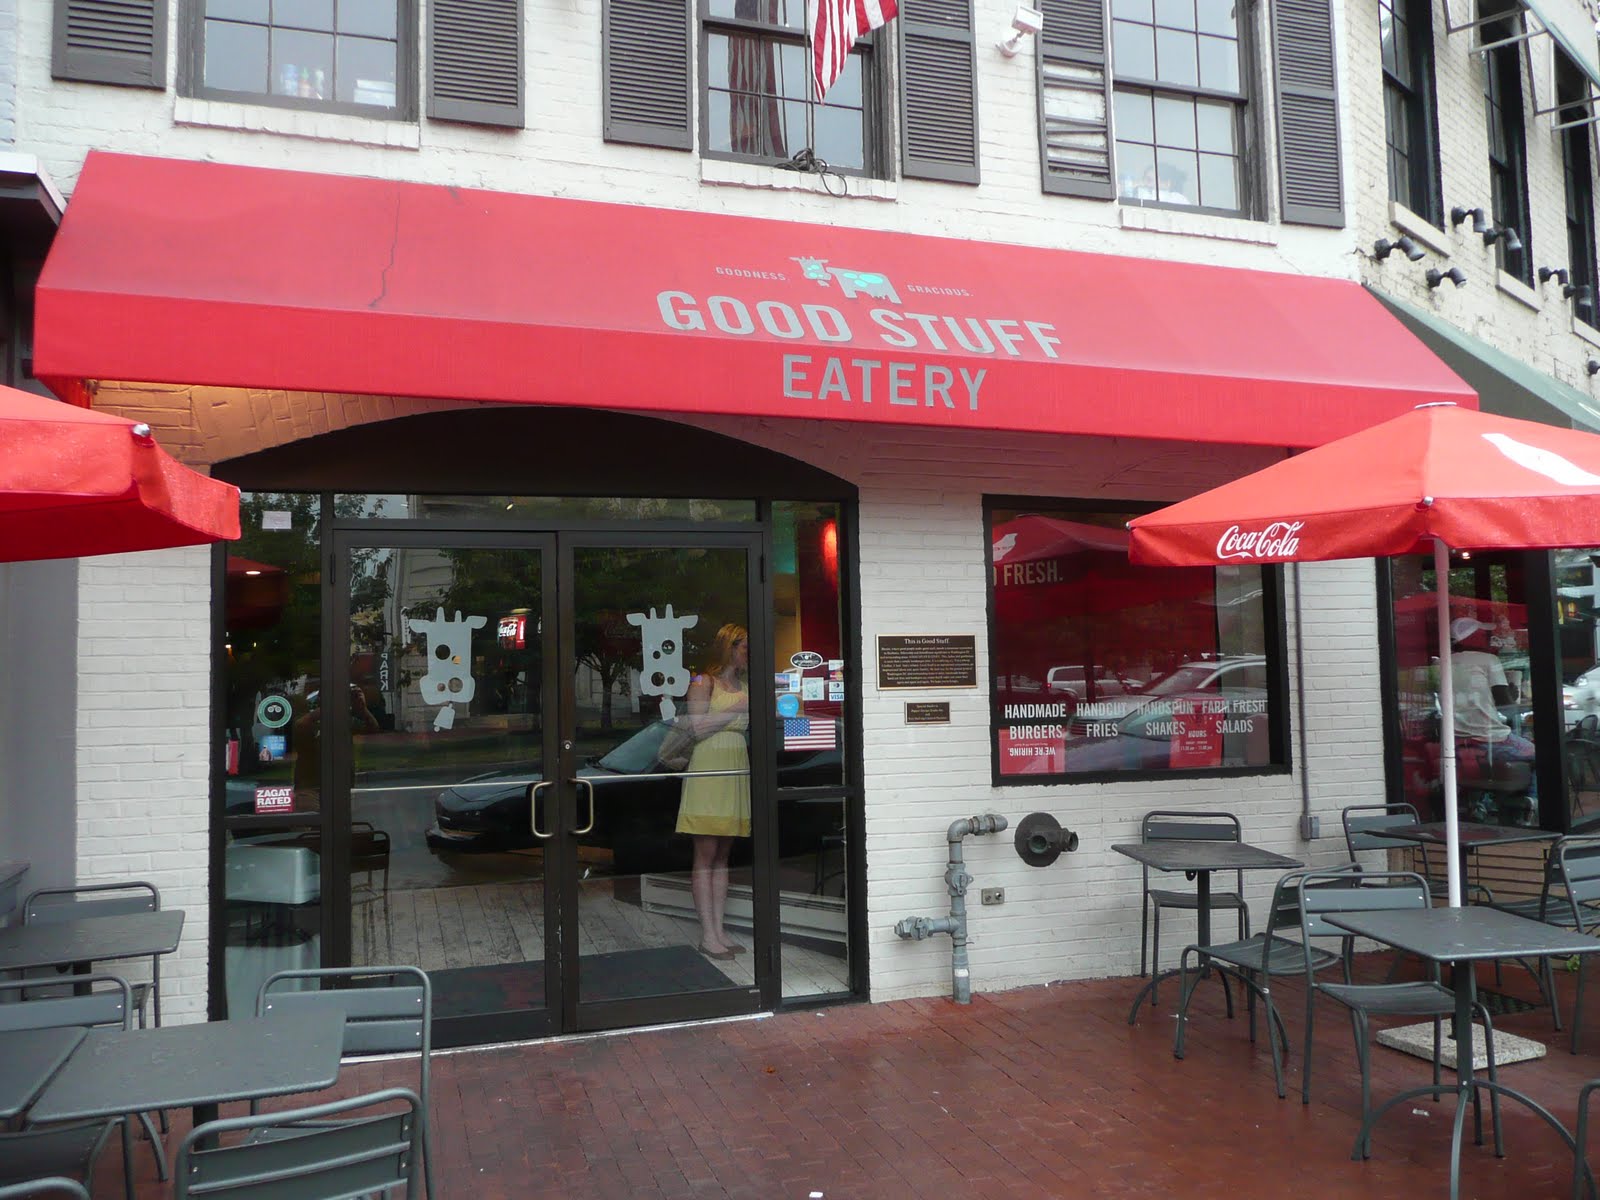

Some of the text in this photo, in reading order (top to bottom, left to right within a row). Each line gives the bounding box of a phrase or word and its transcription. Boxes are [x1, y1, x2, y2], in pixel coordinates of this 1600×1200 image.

[656, 290, 1061, 358] GOOD STUFF
[782, 354, 987, 410] EATERY
[1216, 521, 1305, 559] Coca-Cola
[1003, 560, 1063, 586] FRESH.
[1005, 703, 1066, 718] HANDMADE
[1076, 702, 1127, 717] HANDCUT
[1136, 700, 1194, 715] HANDSPUN
[1202, 699, 1265, 713] FARM FRESH
[1009, 725, 1063, 740] BURGERS
[1086, 723, 1118, 737] FRIES
[1146, 721, 1185, 736] SHAKES
[1188, 730, 1207, 738] HOURS
[1215, 720, 1253, 733] SALADS
[1035, 747, 1056, 756] WE'RE
[256, 788, 291, 798] ZAGAT
[256, 796, 291, 806] RATED
